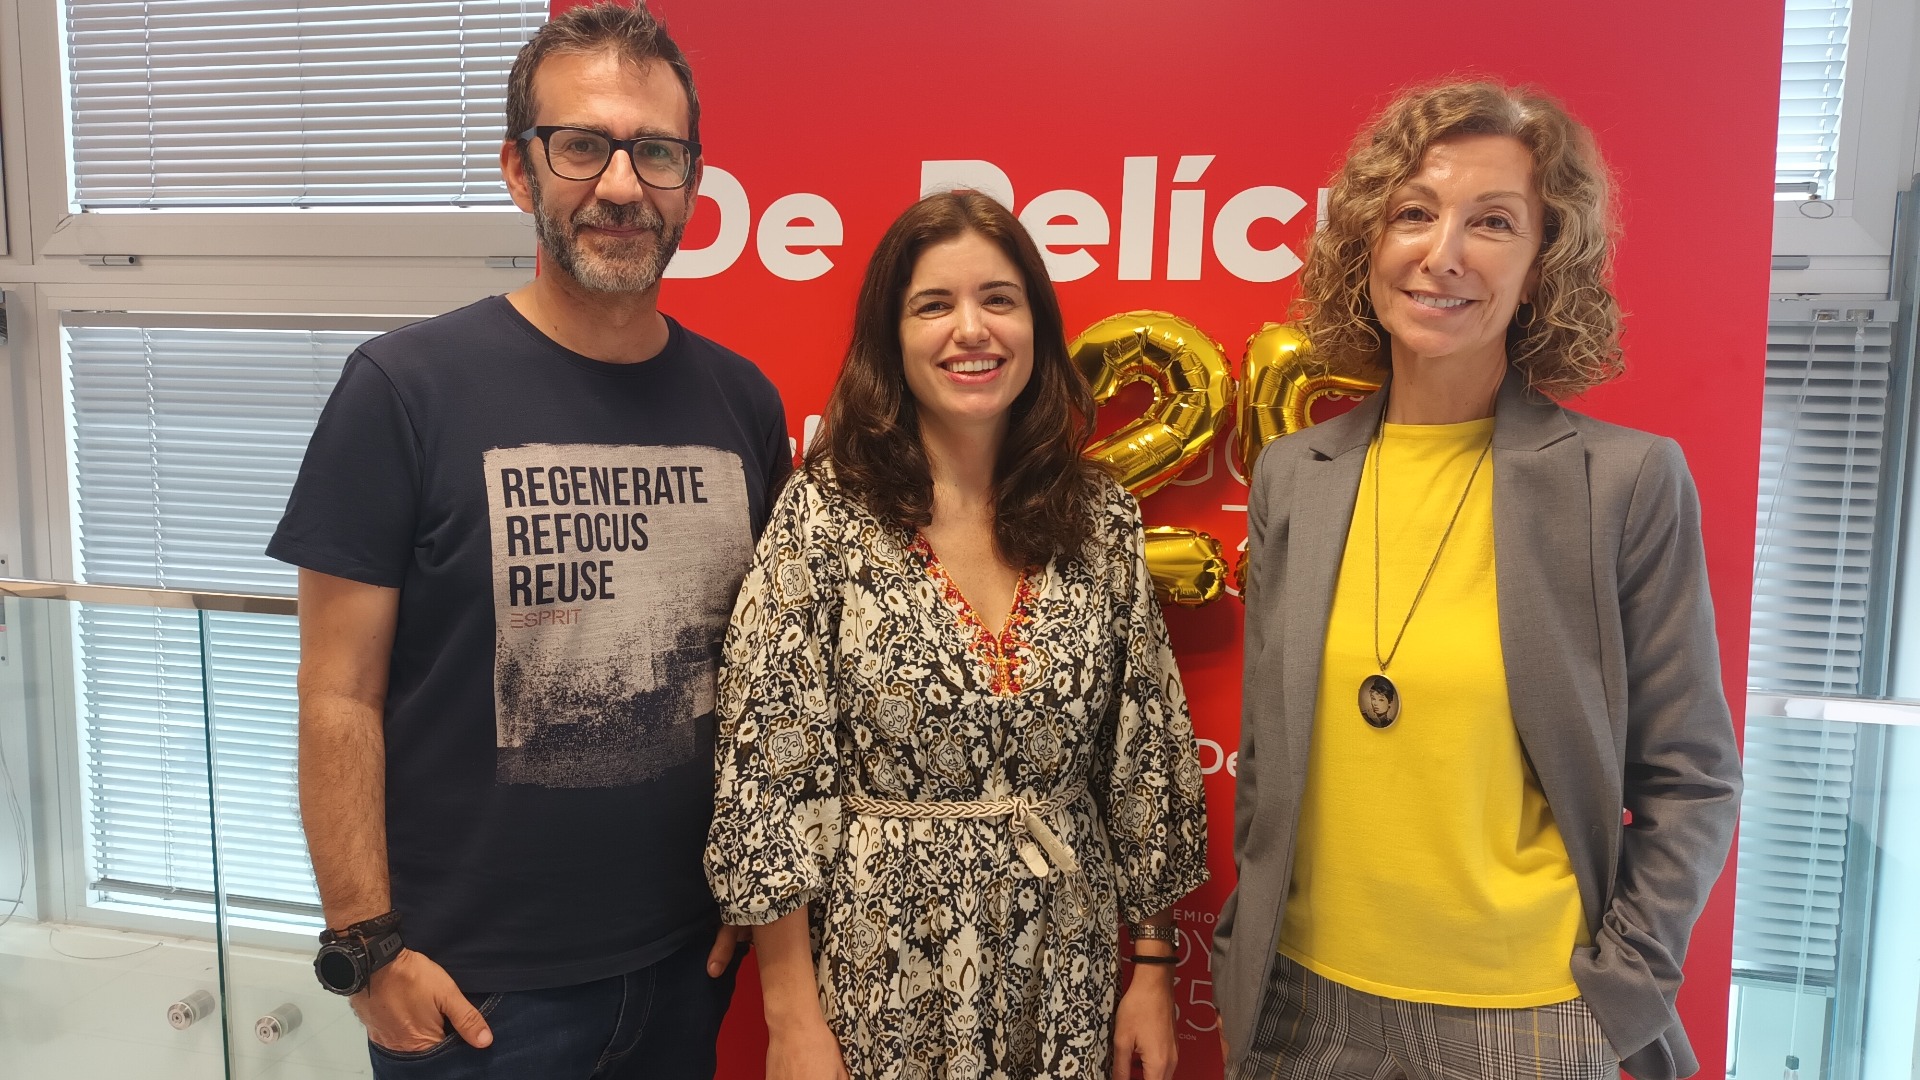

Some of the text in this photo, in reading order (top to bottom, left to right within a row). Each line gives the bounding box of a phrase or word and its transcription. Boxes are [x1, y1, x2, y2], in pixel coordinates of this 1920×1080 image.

[662, 154, 1331, 283] De elíc
[501, 466, 708, 508] REGENERATE
[506, 512, 649, 556] REFOCUS
[508, 560, 615, 606] REUSE
[510, 608, 582, 629] ESPRIT
